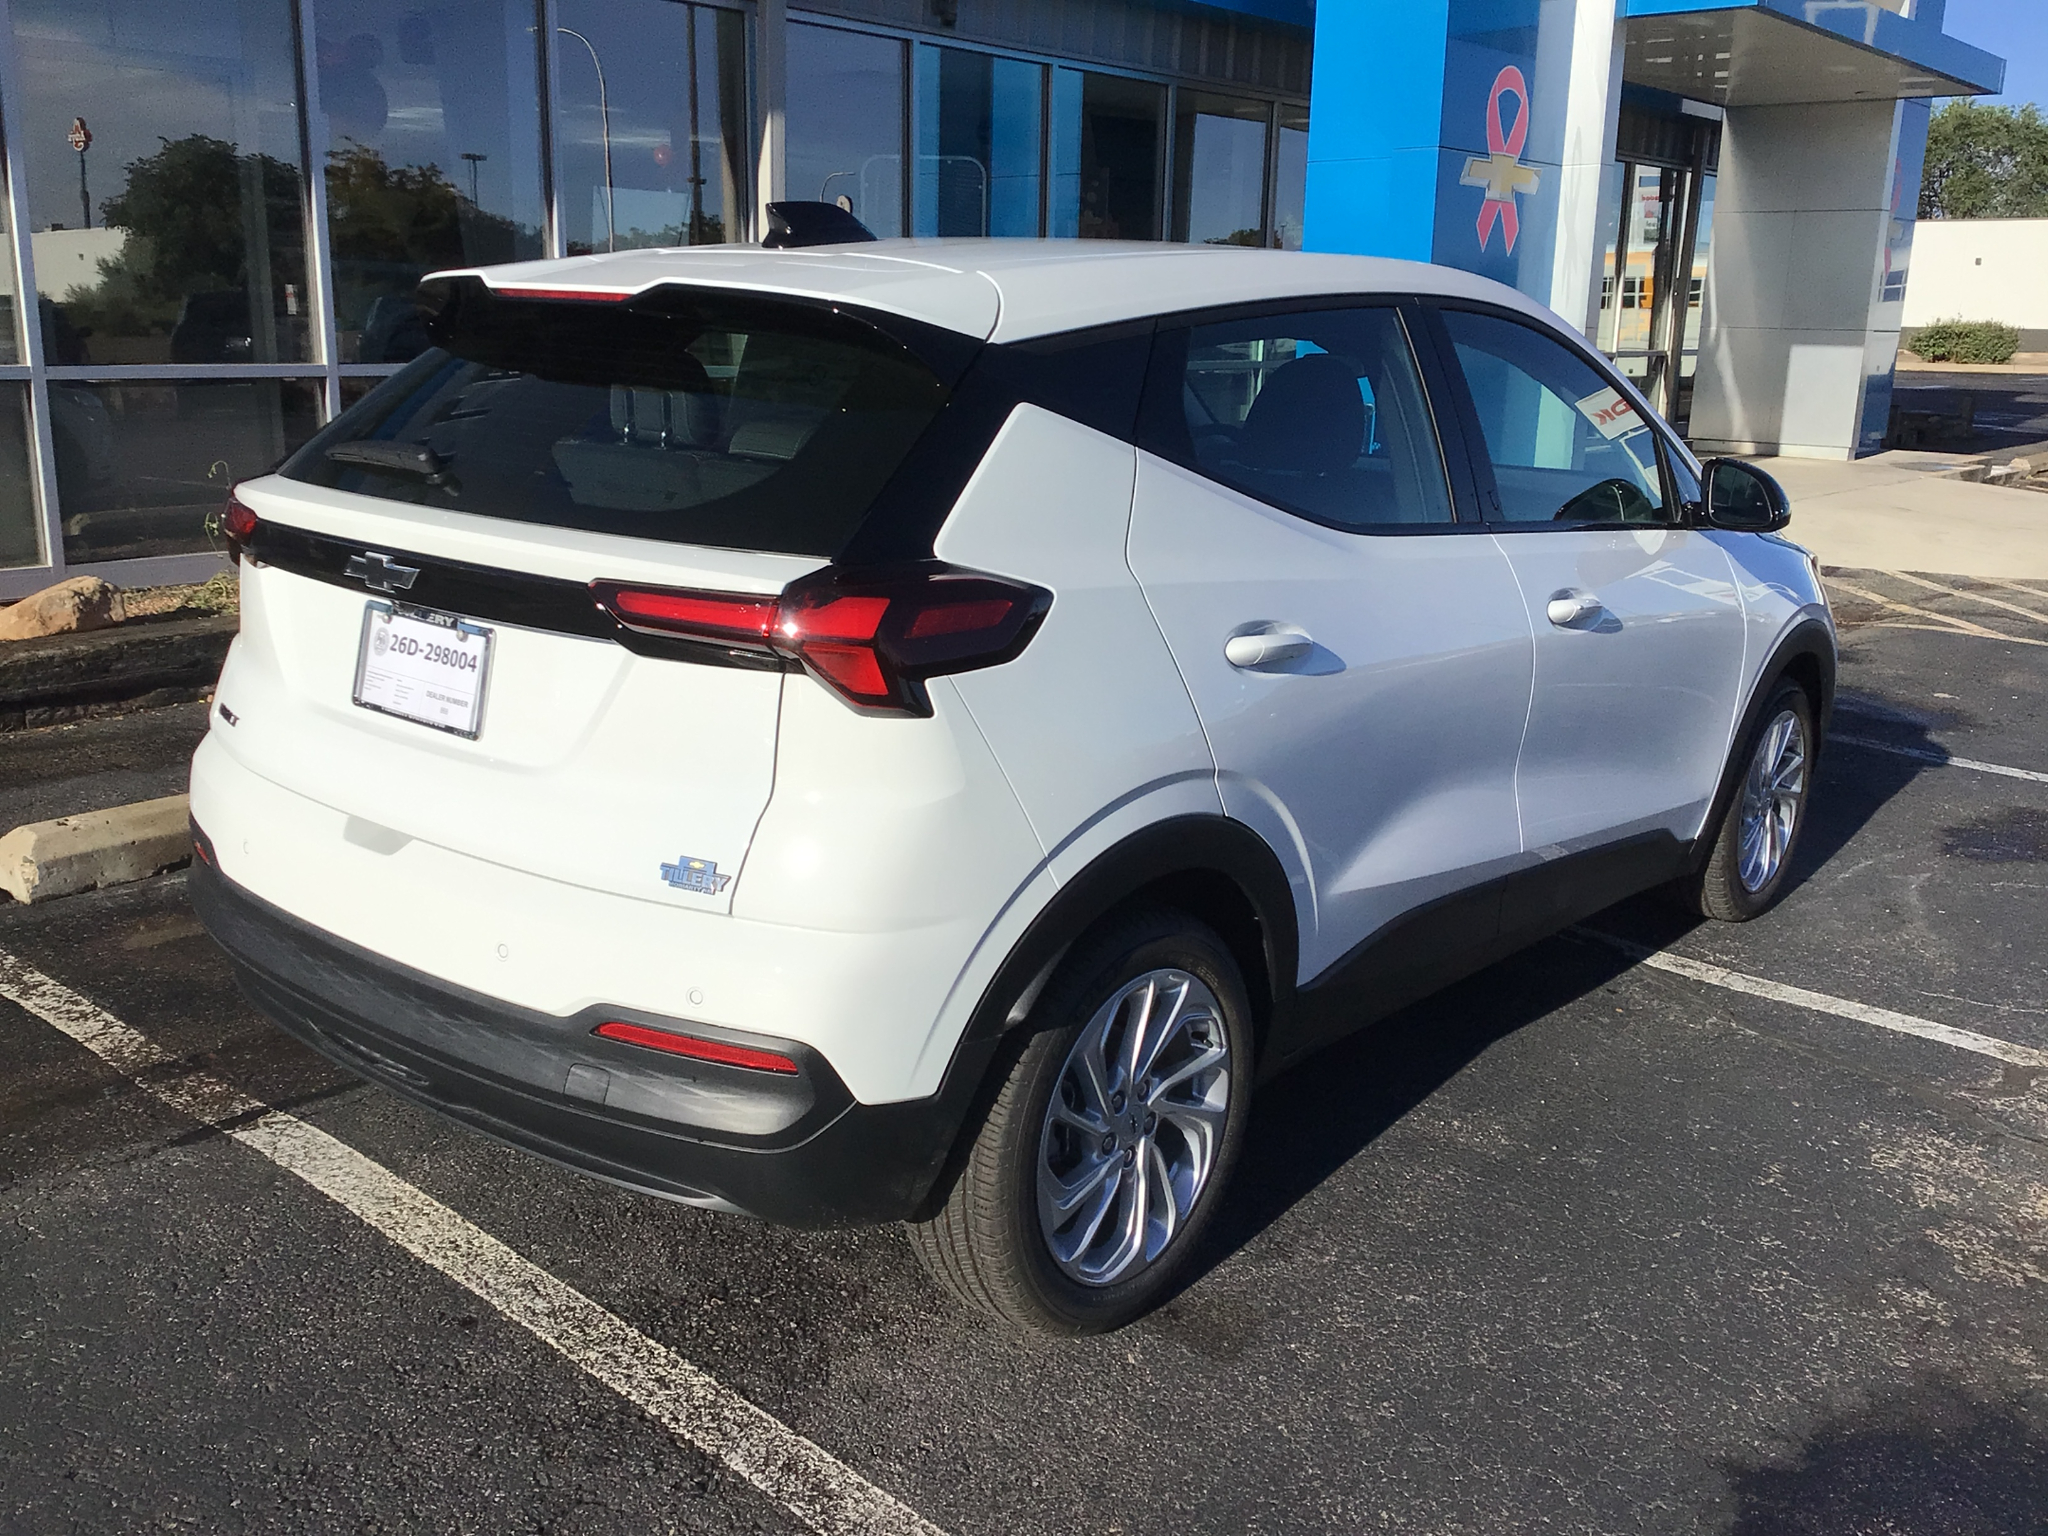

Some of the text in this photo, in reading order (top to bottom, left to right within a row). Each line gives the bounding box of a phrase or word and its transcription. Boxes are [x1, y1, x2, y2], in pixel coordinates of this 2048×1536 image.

[389, 633, 478, 673] 26D-298004
[425, 690, 446, 702] DEALER
[660, 865, 729, 892] TILLERY
